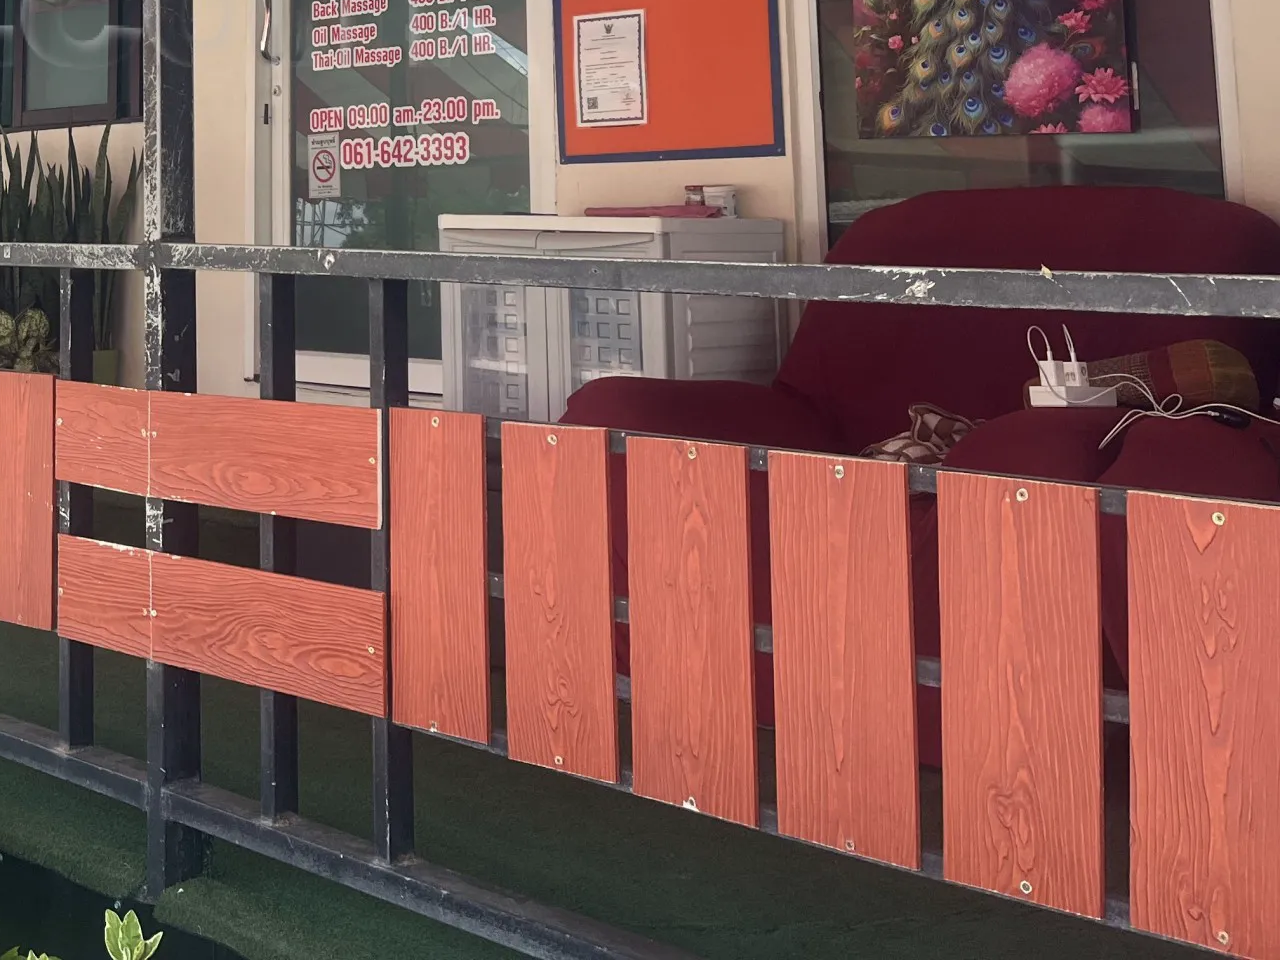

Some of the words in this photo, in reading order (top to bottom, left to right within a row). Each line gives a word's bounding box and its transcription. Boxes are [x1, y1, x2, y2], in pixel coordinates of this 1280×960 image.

[312, 0, 338, 20] Back
[312, 27, 328, 46] Oil
[331, 24, 377, 44] Massage
[410, 14, 436, 33] 400
[472, 5, 496, 27] HR.
[312, 50, 351, 71] Thai-Oil
[354, 47, 402, 66] Massage
[409, 42, 435, 61] 400
[472, 33, 495, 55] HR.
[310, 109, 344, 131] OPEN
[347, 104, 389, 128] 09.00
[472, 99, 500, 124] pm.
[341, 132, 469, 170] 061-642-3393
